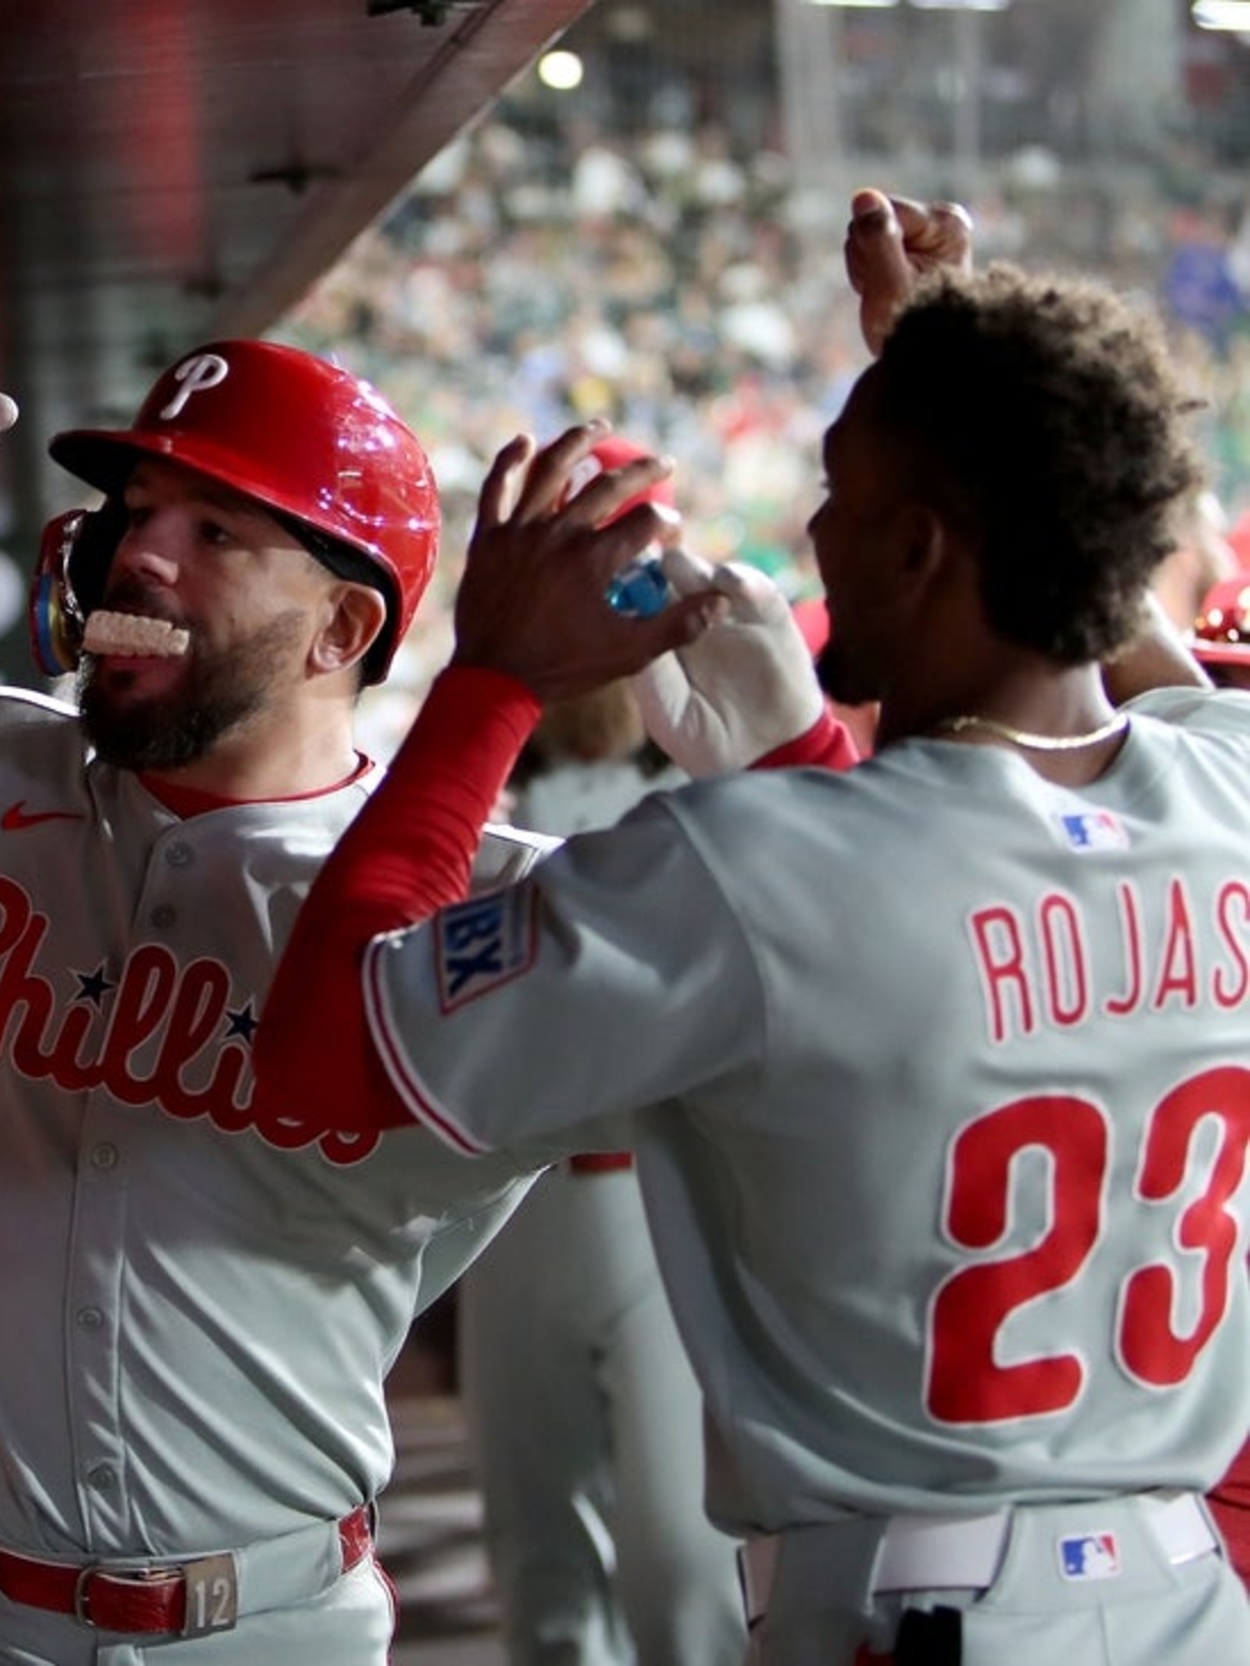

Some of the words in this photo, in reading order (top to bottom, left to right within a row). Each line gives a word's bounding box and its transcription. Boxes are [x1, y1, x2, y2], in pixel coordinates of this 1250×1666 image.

[159, 353, 229, 420] P
[968, 877, 1250, 1043] ROJAS
[924, 1064, 1250, 1428] 23
[195, 1578, 230, 1629] 12
